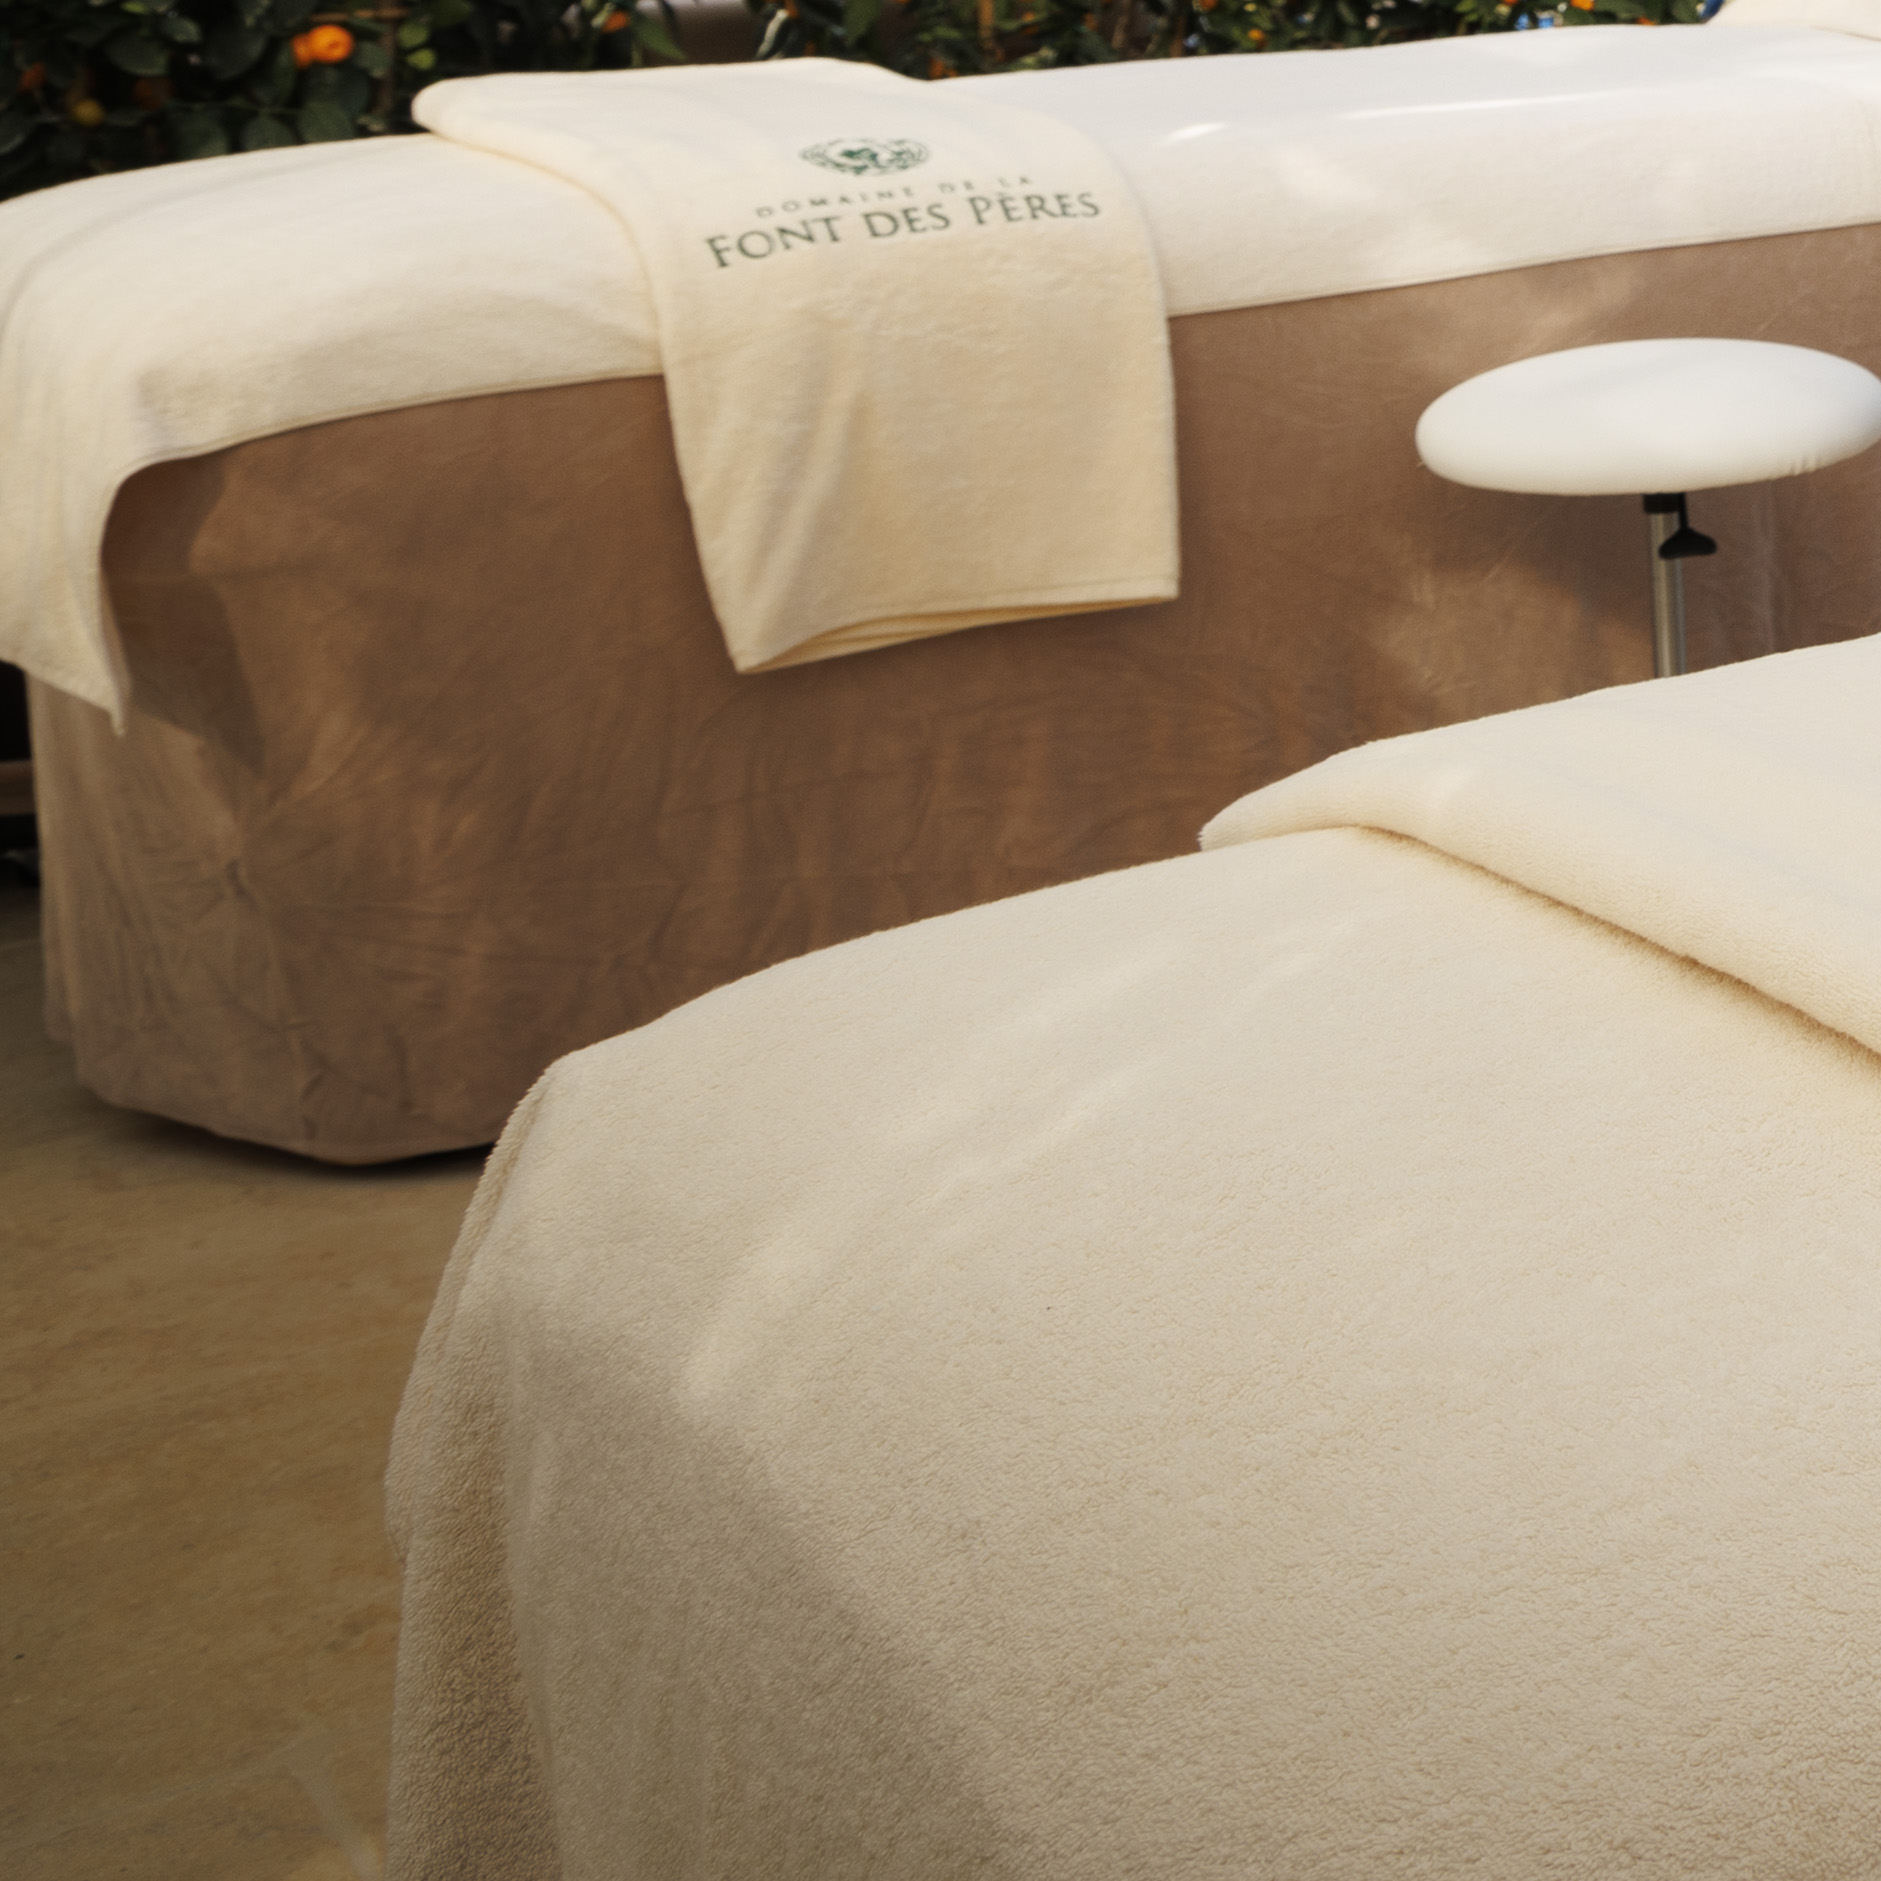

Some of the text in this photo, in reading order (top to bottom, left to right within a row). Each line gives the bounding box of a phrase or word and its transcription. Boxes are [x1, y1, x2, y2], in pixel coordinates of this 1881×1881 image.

[705, 190, 1101, 269] FONT DES PÈRES
[755, 186, 914, 218] DOMAINE
